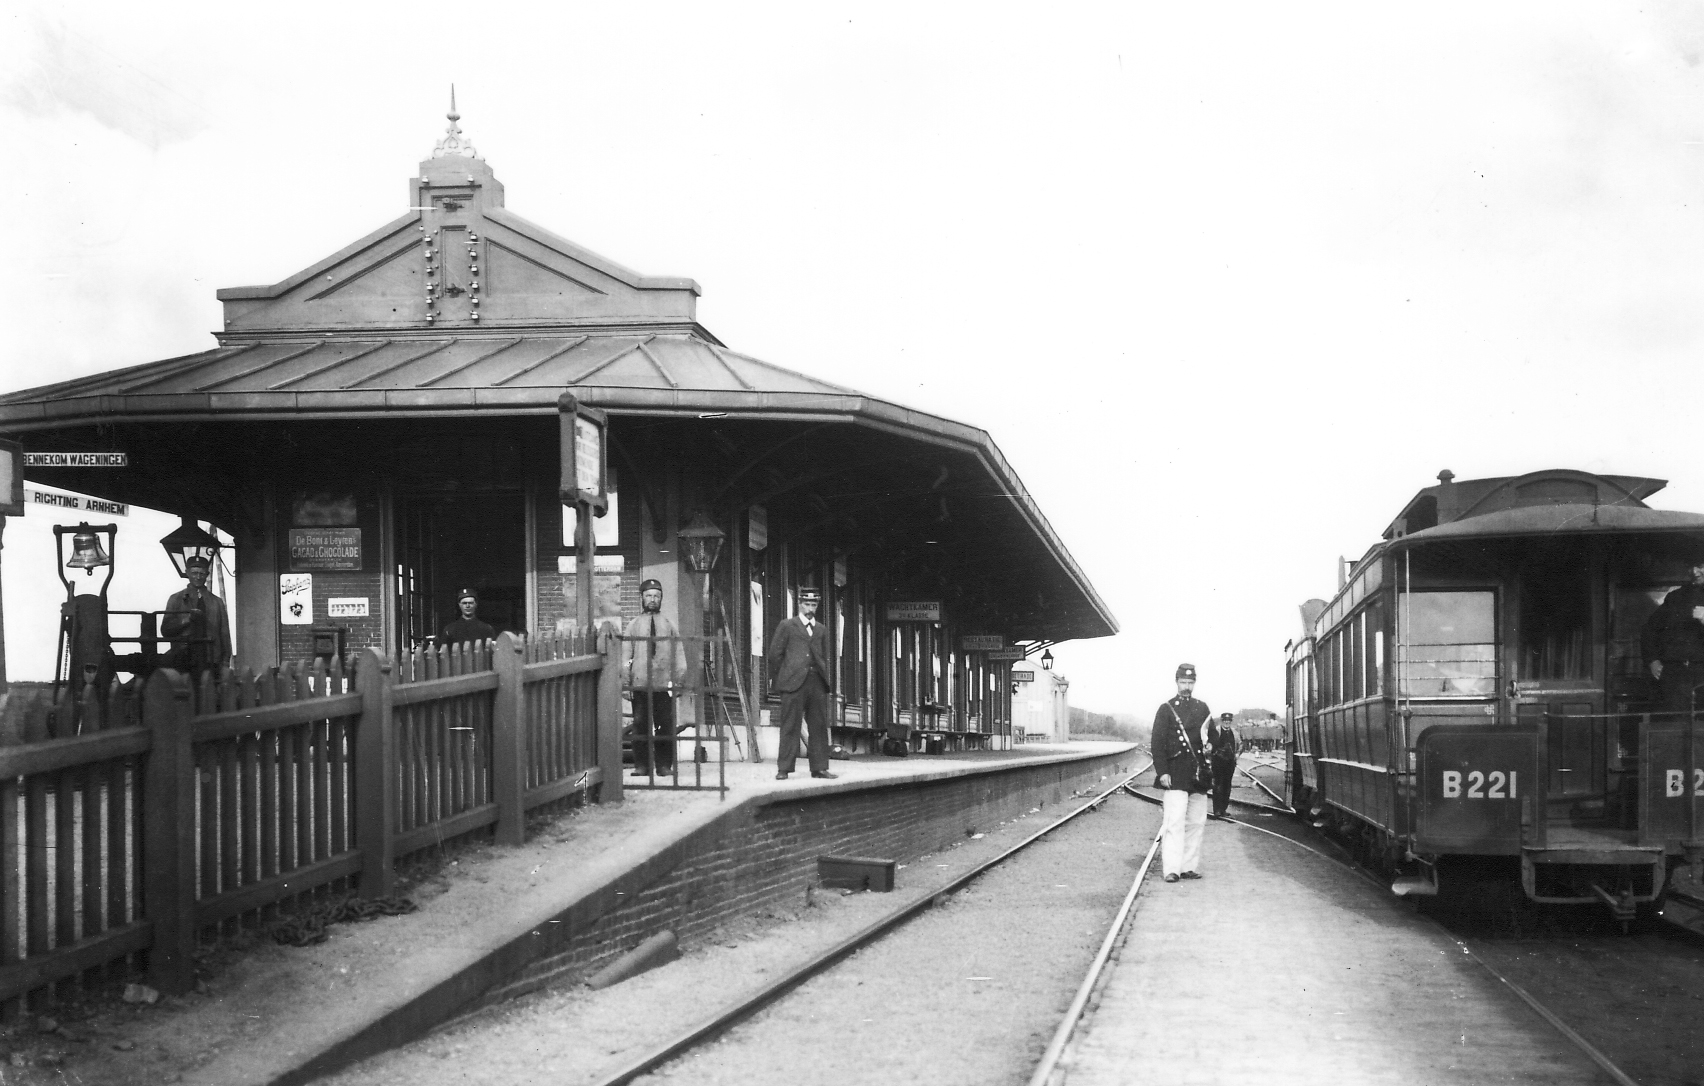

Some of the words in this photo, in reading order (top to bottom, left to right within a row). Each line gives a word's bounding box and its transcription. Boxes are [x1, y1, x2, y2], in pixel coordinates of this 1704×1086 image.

[23, 454, 67, 465] BENNEKOM
[69, 454, 127, 465] WAGENINGEN
[34, 492, 79, 508] RIGHTING
[86, 499, 125, 515] ARNHEM
[319, 546, 359, 558] CHOCOLADE
[1443, 770, 1517, 799] B221
